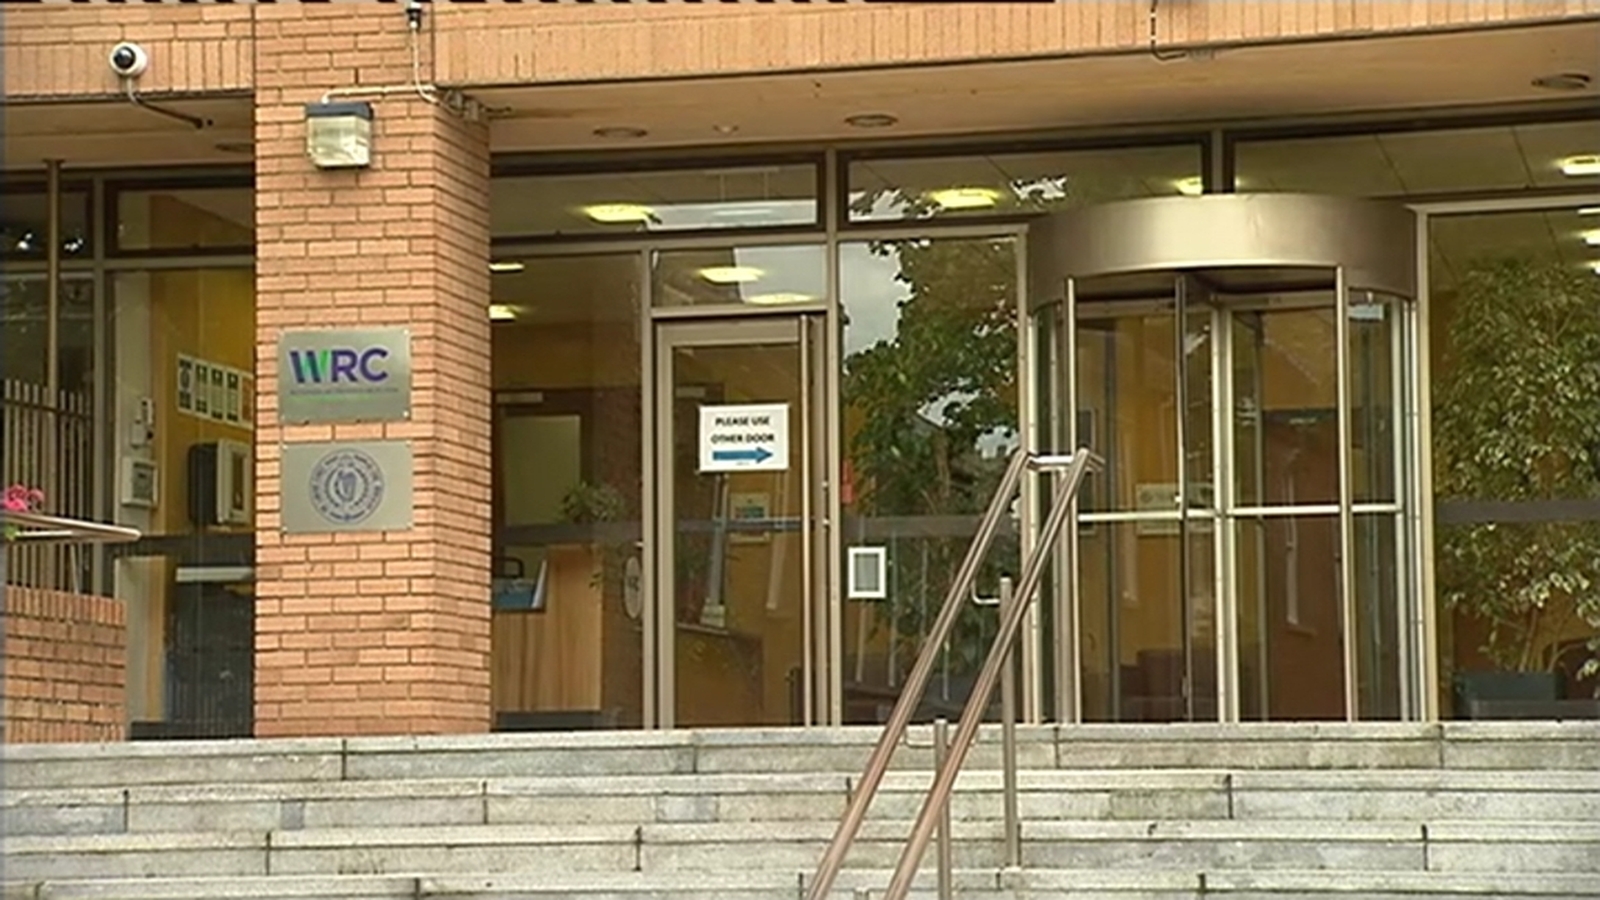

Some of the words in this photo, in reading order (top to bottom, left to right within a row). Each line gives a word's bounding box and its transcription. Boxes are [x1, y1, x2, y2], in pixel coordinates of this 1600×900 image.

[290, 348, 388, 383] WRC
[715, 417, 748, 427] PLEASE
[751, 416, 769, 427] USE
[711, 433, 742, 445] OTHER
[746, 432, 774, 444] DOOR
